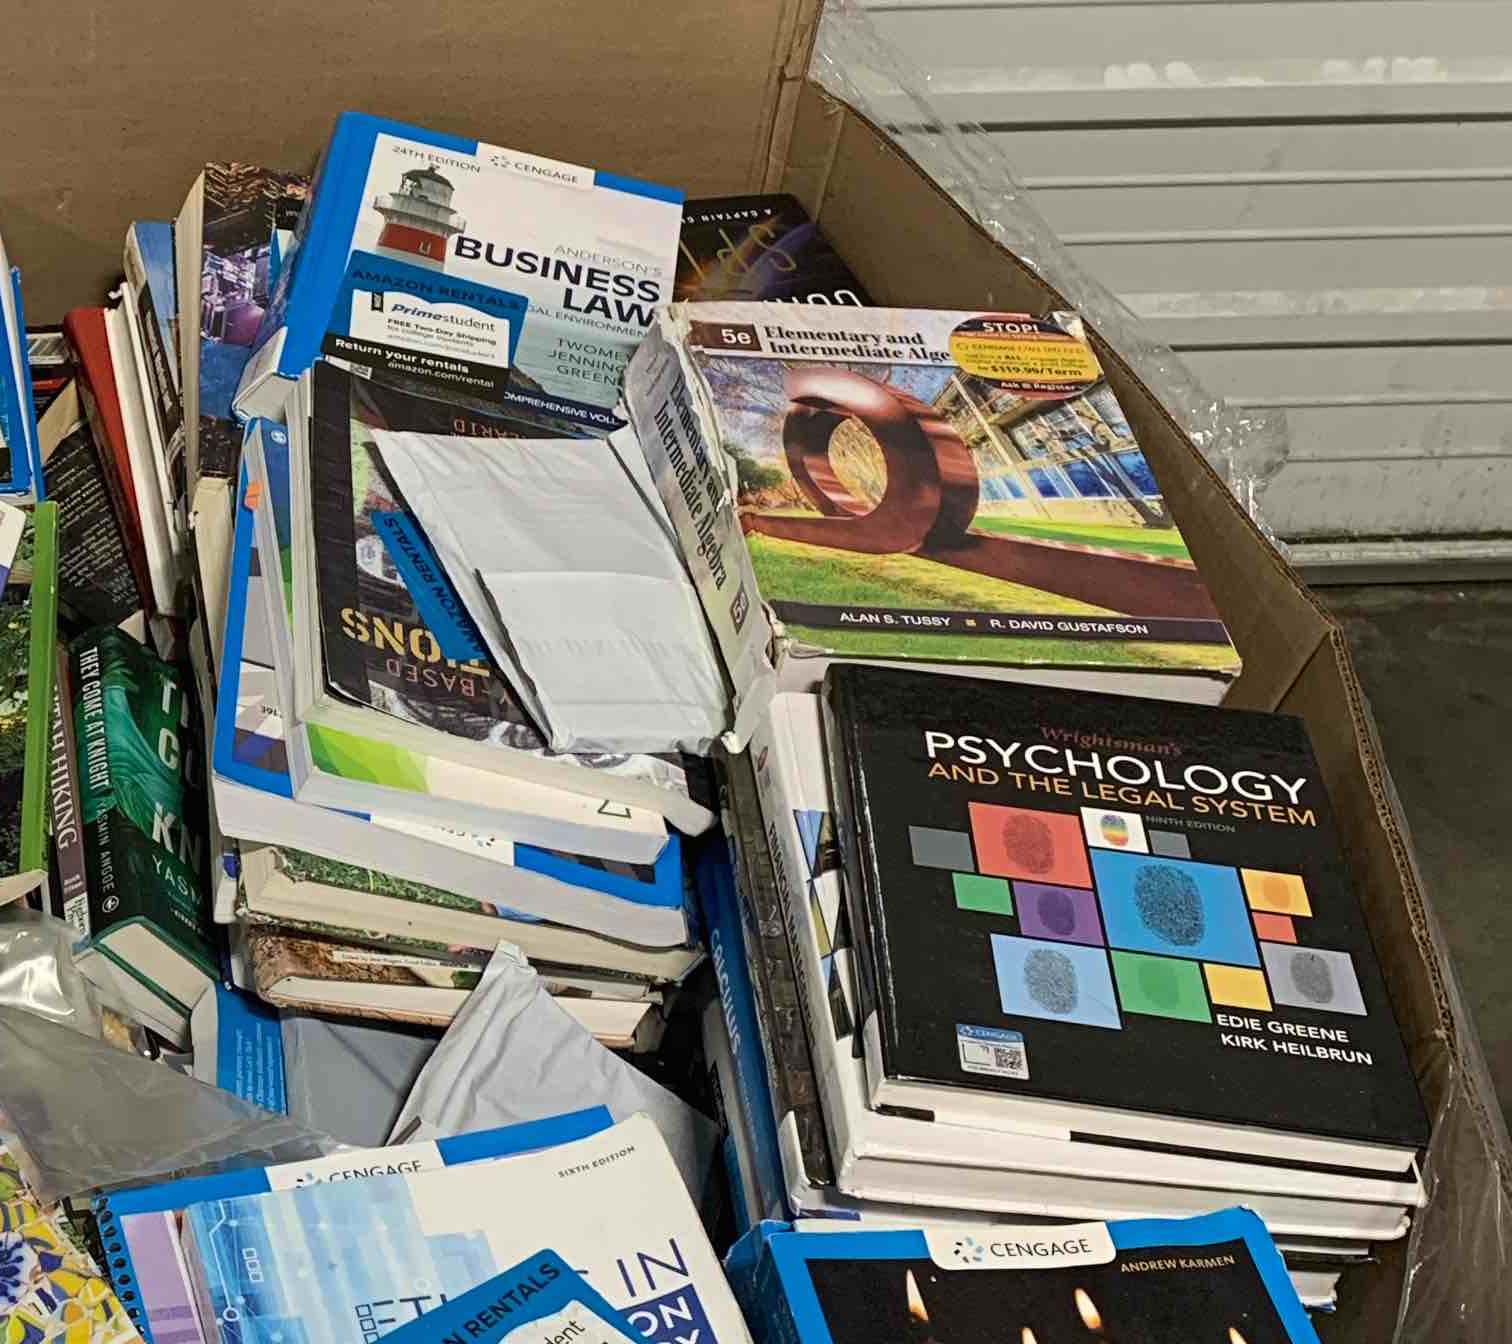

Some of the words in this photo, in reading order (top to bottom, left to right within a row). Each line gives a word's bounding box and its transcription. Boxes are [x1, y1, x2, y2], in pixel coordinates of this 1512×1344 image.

[428, 153, 481, 174] EDITION
[514, 160, 579, 185] CENGAGE
[454, 234, 663, 304] BUSINESS
[562, 287, 657, 329] LAW
[721, 328, 751, 345] 5e
[764, 325, 881, 349] Elementary
[885, 330, 925, 346] and
[982, 321, 1040, 335] STOP!
[335, 338, 382, 361] Return
[384, 348, 417, 364] your
[420, 353, 470, 375] rentals
[769, 340, 892, 363] Intermediate
[654, 399, 704, 520] Intermediate
[694, 517, 729, 592] Algebra
[839, 610, 879, 625] ALAN
[883, 612, 897, 626] S.
[900, 614, 953, 629] TUSSY
[990, 618, 1004, 632] R.
[1006, 619, 1054, 634] DAVID
[1057, 621, 1150, 638] GUSTAFSON
[79, 645, 101, 685] THEY
[82, 684, 104, 722] COME
[85, 720, 105, 738] AT
[1040, 724, 1184, 757] Wrightsman's
[87, 737, 111, 792] KNIGHT
[924, 730, 1307, 806] PSYCHOLOGY
[51, 755, 79, 849] HIKING
[928, 761, 1000, 786] AND
[1008, 770, 1073, 797] THE
[1080, 782, 1185, 812] LEGAL
[1191, 795, 1318, 829] SYSTEM
[1145, 814, 1185, 827] NINTH
[1186, 818, 1237, 834] EDITION
[1216, 1013, 1263, 1032] EDIE
[1268, 1020, 1349, 1045] GREENE
[1220, 1033, 1269, 1053] KIRK
[1273, 1038, 1373, 1067] HEILBRUN
[557, 1163, 589, 1178] SIXTH
[591, 1144, 637, 1170] EDITION
[990, 1238, 1093, 1259] CENGAGE
[1120, 1258, 1179, 1274] ANDREW
[1179, 1255, 1237, 1270] KARMEN
[615, 1237, 689, 1298] IN
[465, 1262, 561, 1340] RENTALS
